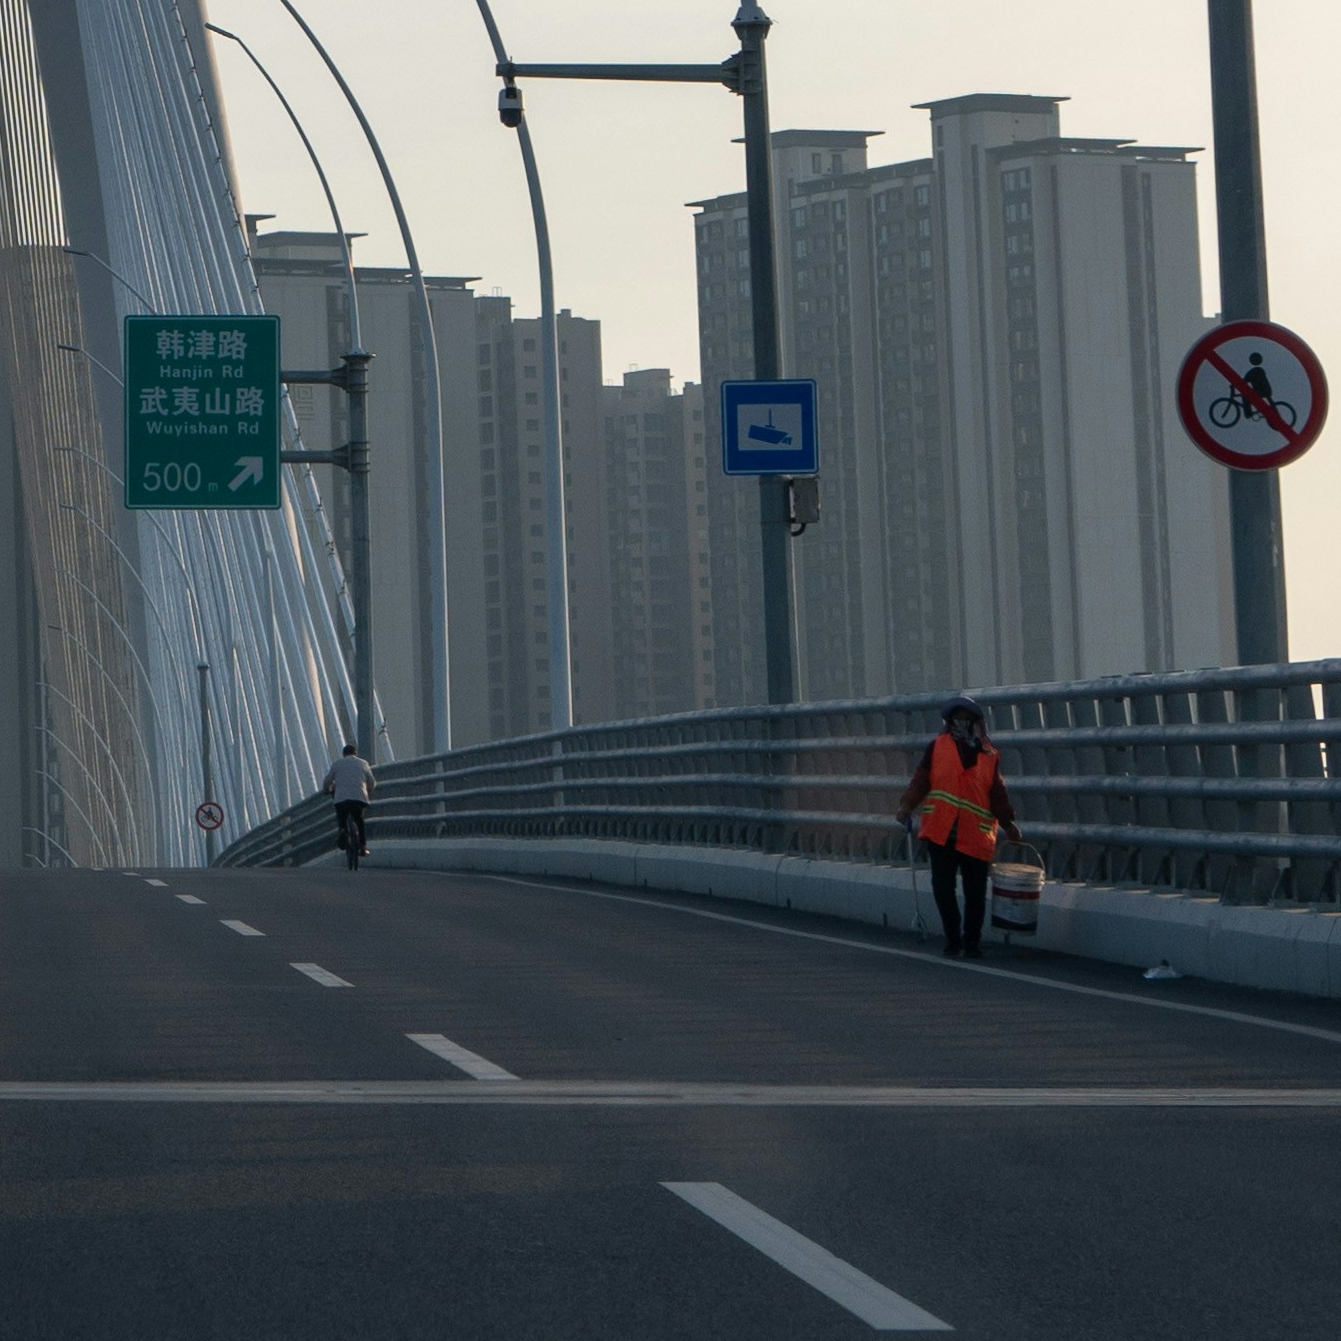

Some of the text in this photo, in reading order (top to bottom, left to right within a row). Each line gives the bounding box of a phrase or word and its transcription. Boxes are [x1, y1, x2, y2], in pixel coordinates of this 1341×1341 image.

[156, 330, 248, 359] 韩津路
[159, 365, 244, 381] Hanjin Rd
[139, 386, 265, 416] 武夷山路
[146, 421, 260, 437] Wuyishan Rd
[143, 462, 202, 492] 500
